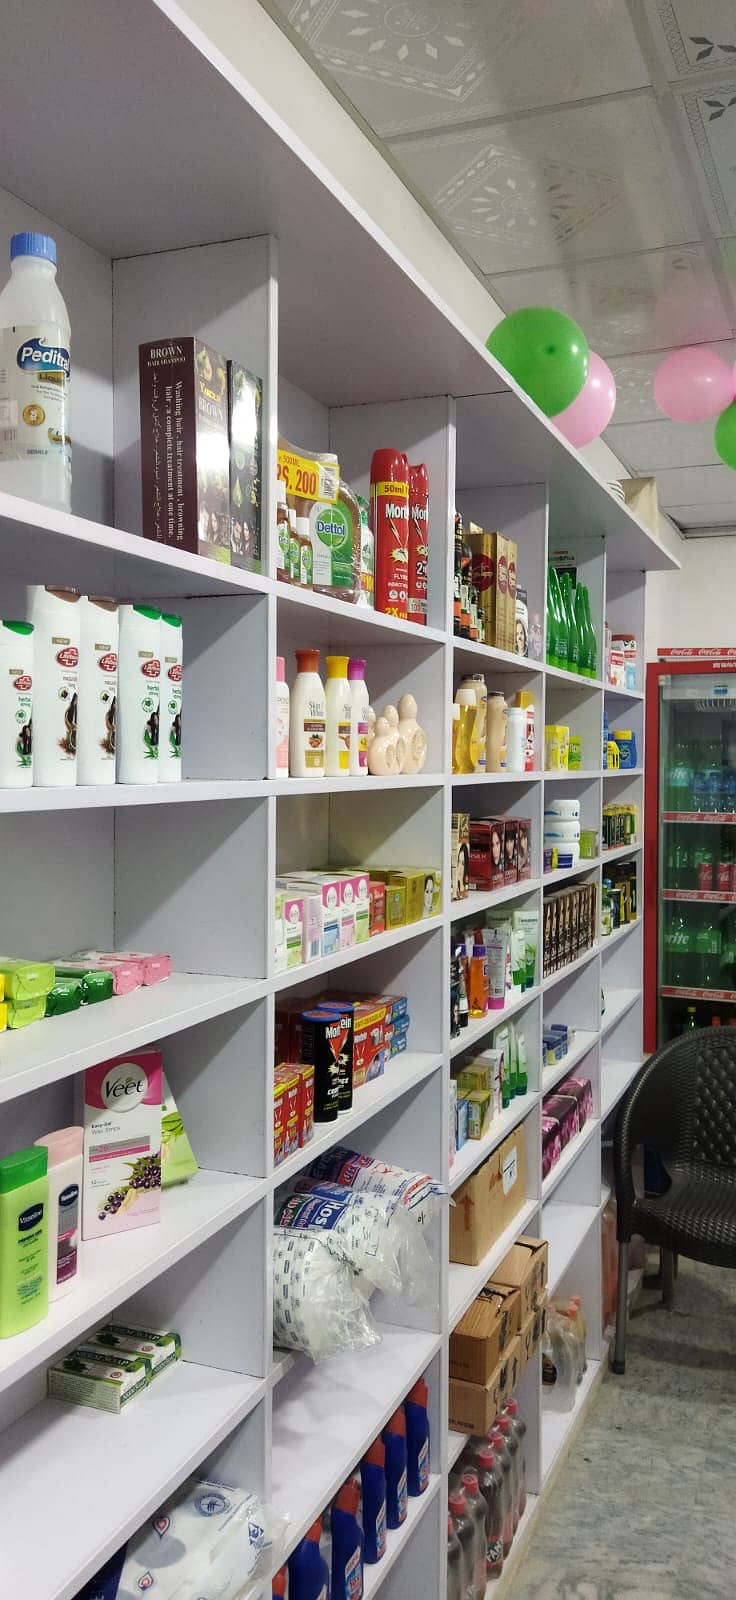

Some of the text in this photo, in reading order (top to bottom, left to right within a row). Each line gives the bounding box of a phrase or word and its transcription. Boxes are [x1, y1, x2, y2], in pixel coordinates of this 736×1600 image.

[150, 345, 183, 359] BROWN
[165, 386, 173, 402] hair
[165, 416, 174, 451] complete
[174, 381, 186, 541] Washing hair hair treatment browning
[166, 453, 175, 491] treatment
[295, 469, 317, 496] 200
[384, 484, 404, 494] 50ml
[317, 521, 346, 536] Dettol
[105, 1079, 145, 1098] Veet
[20, 1209, 43, 1224] Vaseline
